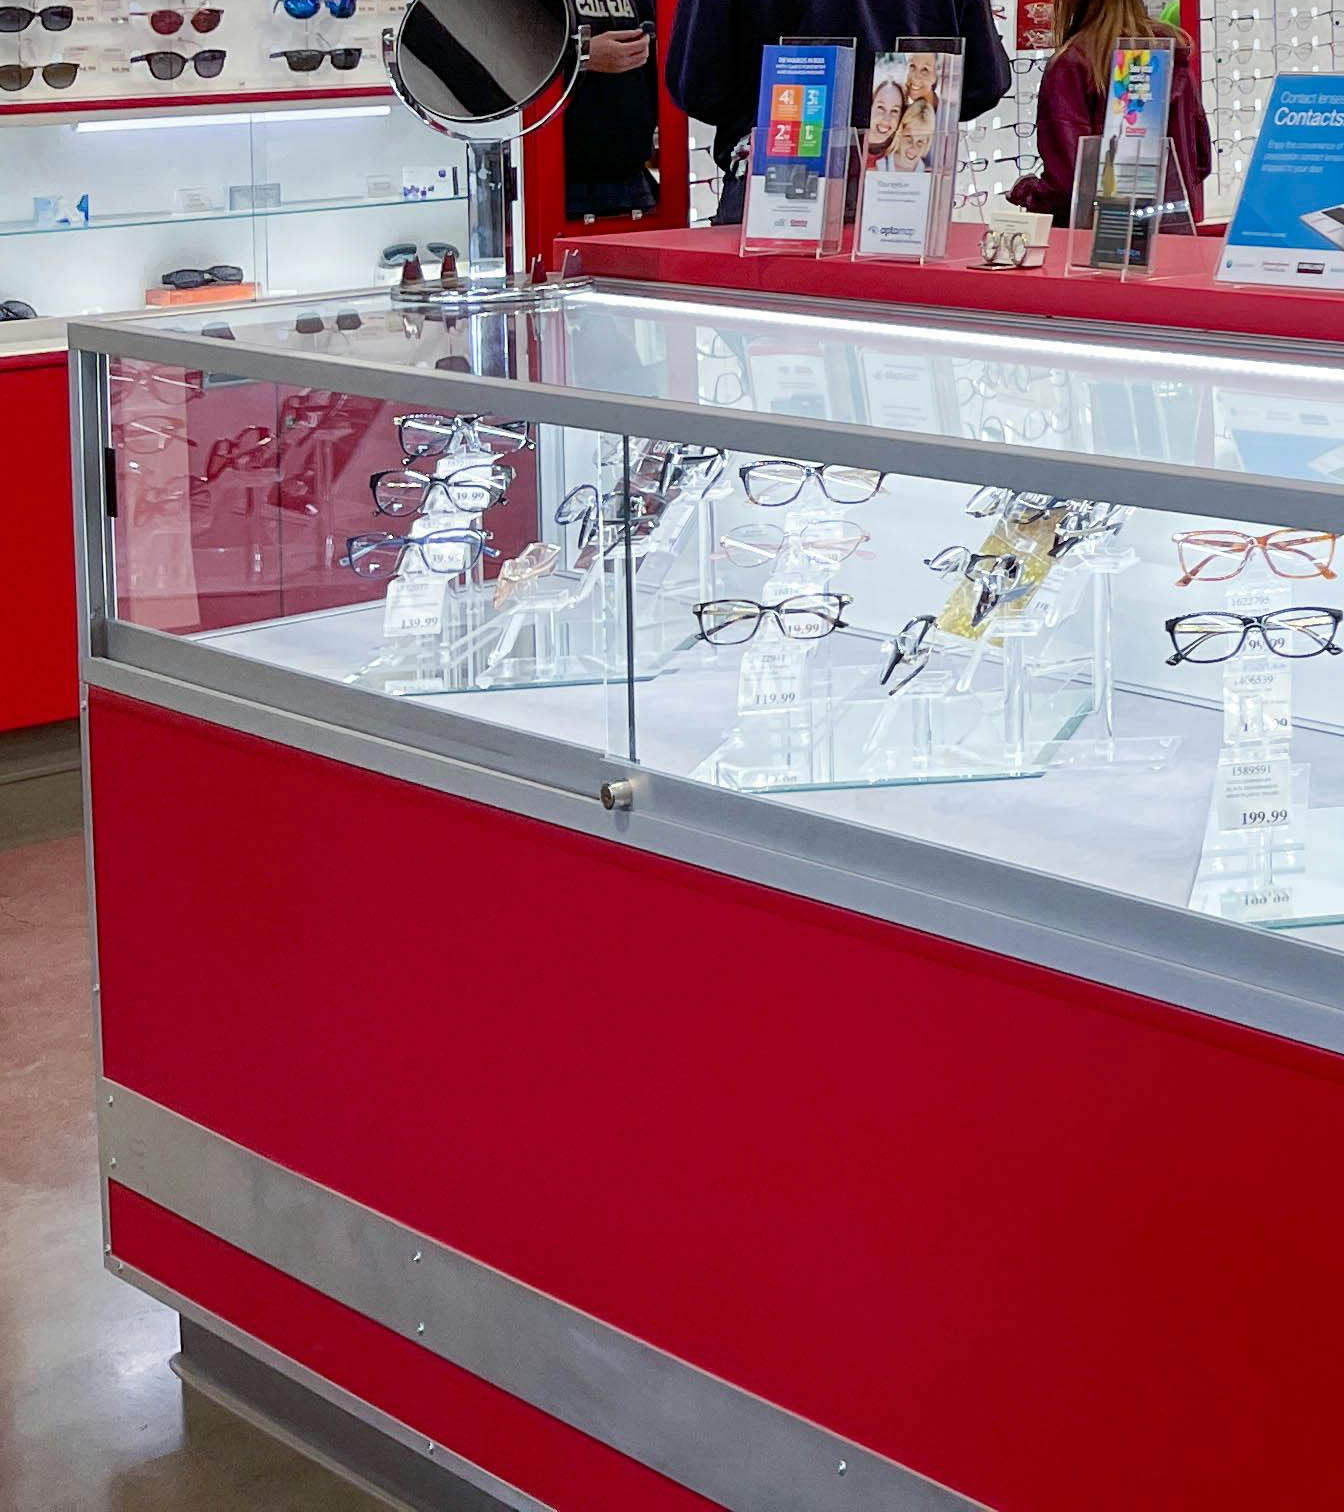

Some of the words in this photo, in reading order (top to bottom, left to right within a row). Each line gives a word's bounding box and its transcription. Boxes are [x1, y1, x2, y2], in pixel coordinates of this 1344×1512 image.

[1280, 90, 1317, 104] Contact
[754, 692, 796, 705] 119.99
[1231, 764, 1272, 777] 1589591
[1241, 809, 1288, 826] 199.99
